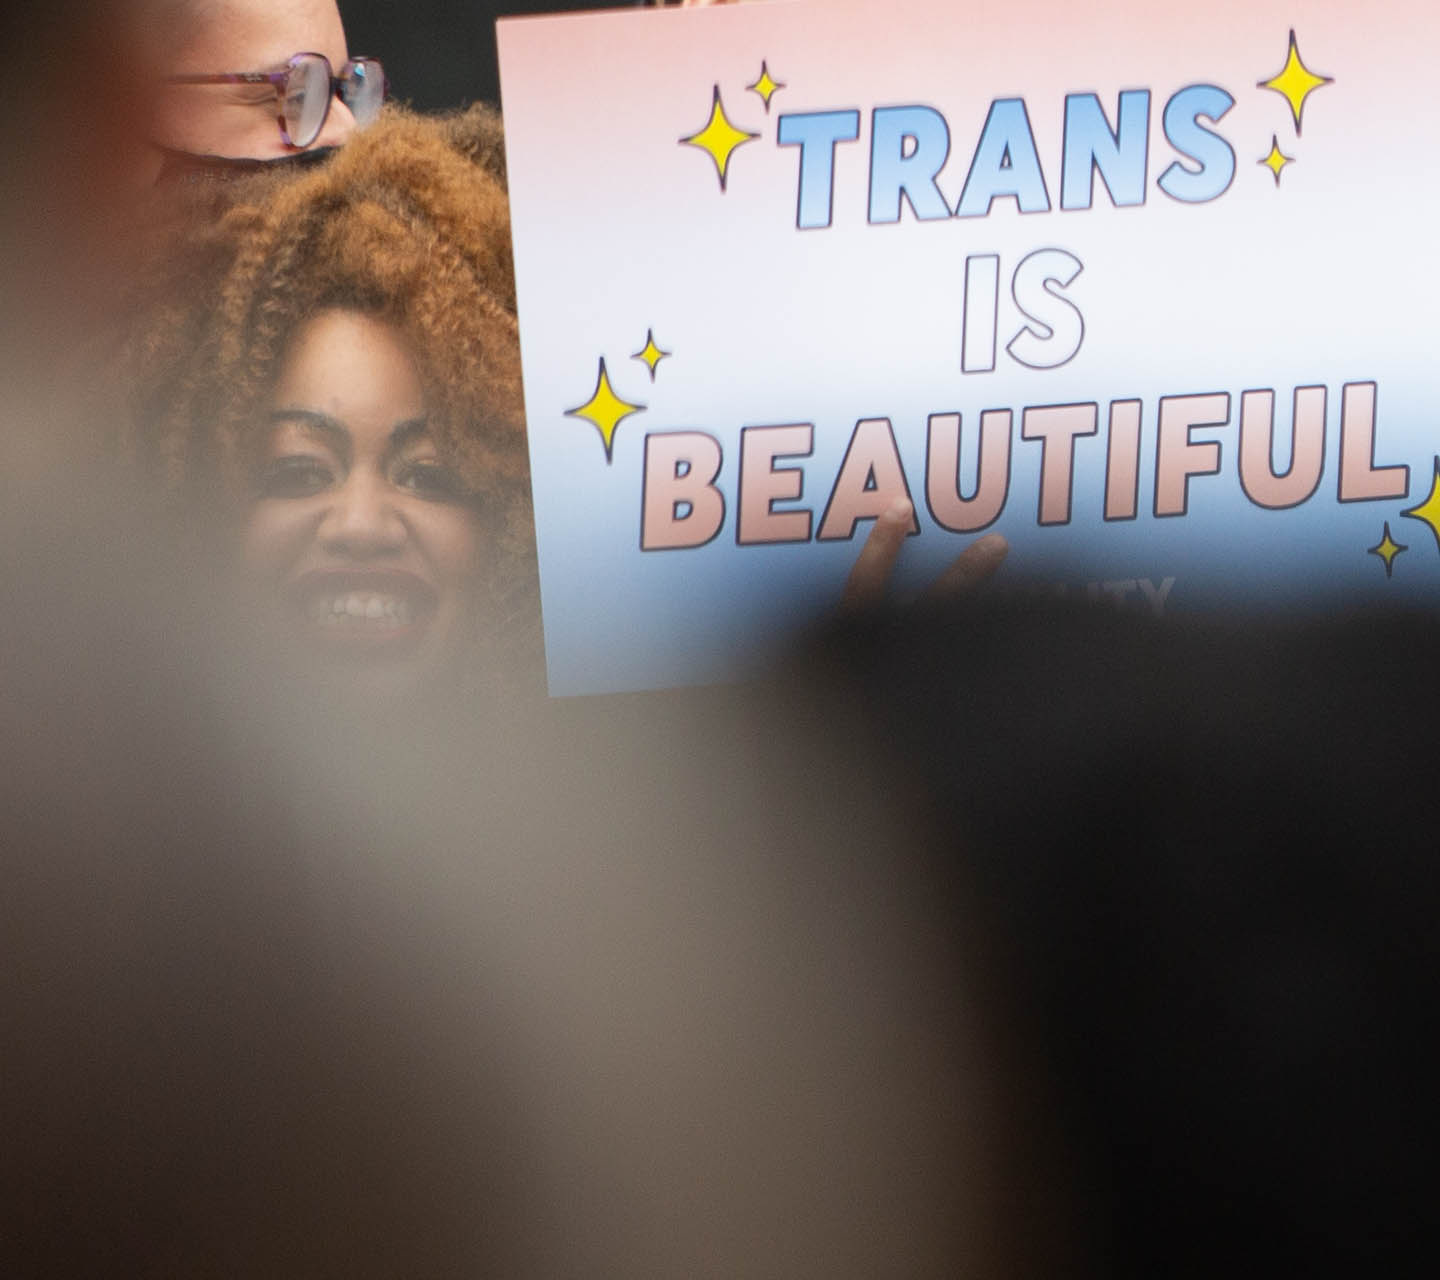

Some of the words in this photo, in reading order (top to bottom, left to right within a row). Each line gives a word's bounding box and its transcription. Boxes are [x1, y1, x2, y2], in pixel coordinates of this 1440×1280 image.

[776, 83, 1237, 230] TRANS
[960, 247, 1086, 374] IS
[638, 380, 1410, 553] BEAUTIFUL
